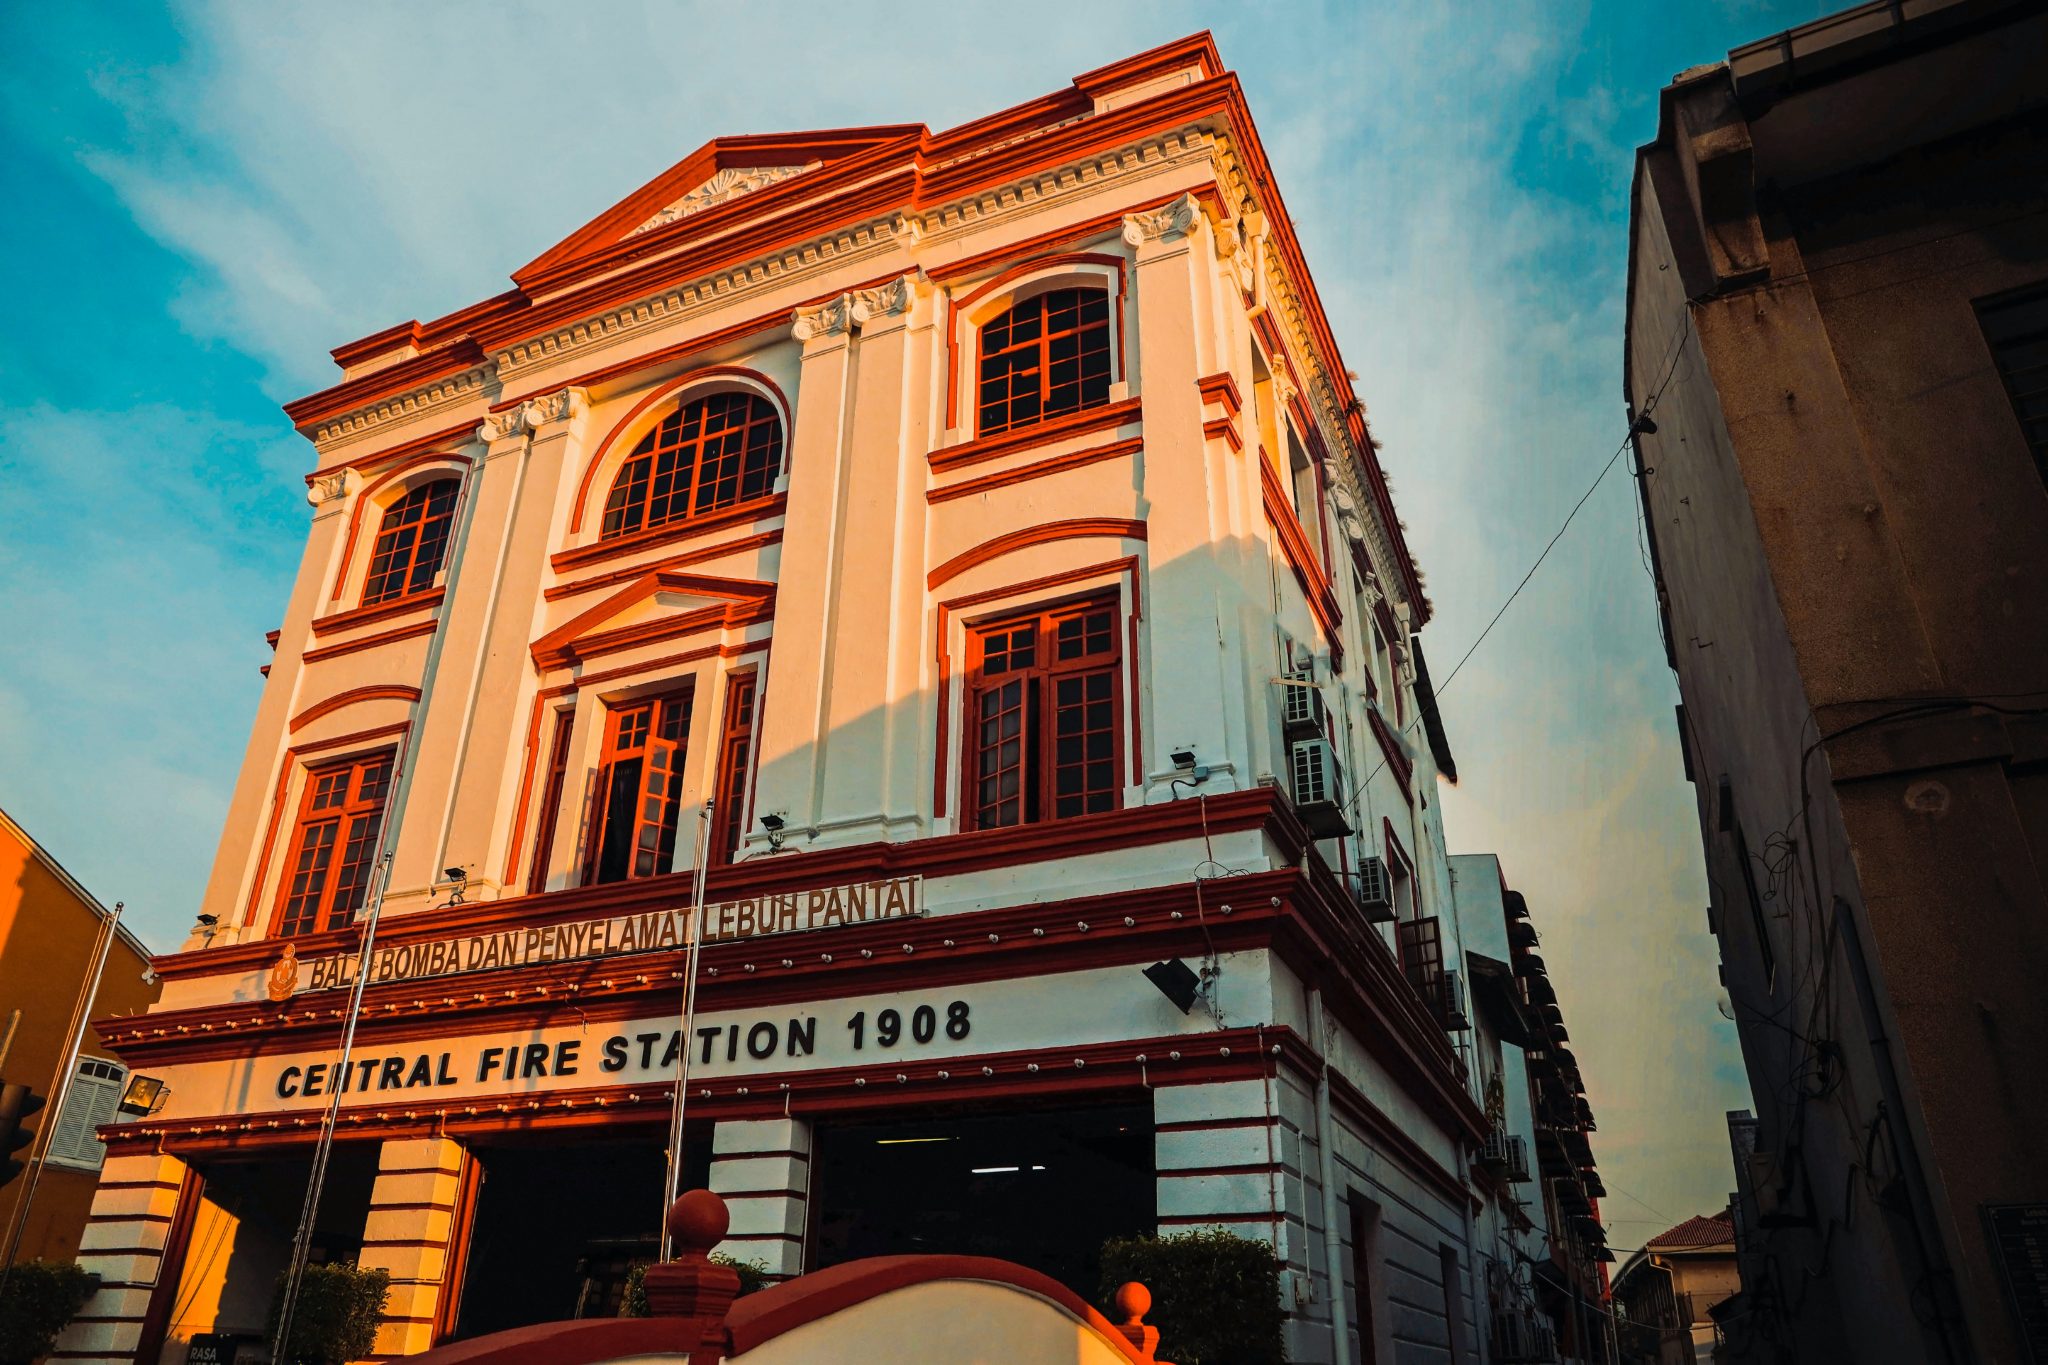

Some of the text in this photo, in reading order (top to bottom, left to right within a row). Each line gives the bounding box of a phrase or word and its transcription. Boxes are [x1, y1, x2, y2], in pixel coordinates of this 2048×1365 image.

[378, 940, 460, 981] BOMBA
[467, 932, 520, 971] DAN
[524, 909, 697, 963] PENYELAMAT
[702, 894, 798, 941] LEBUH
[808, 876, 915, 928] PANTAI
[277, 1000, 971, 1098] CENTRAL FIRE STATION 1908
[190, 1347, 216, 1360] RASA
